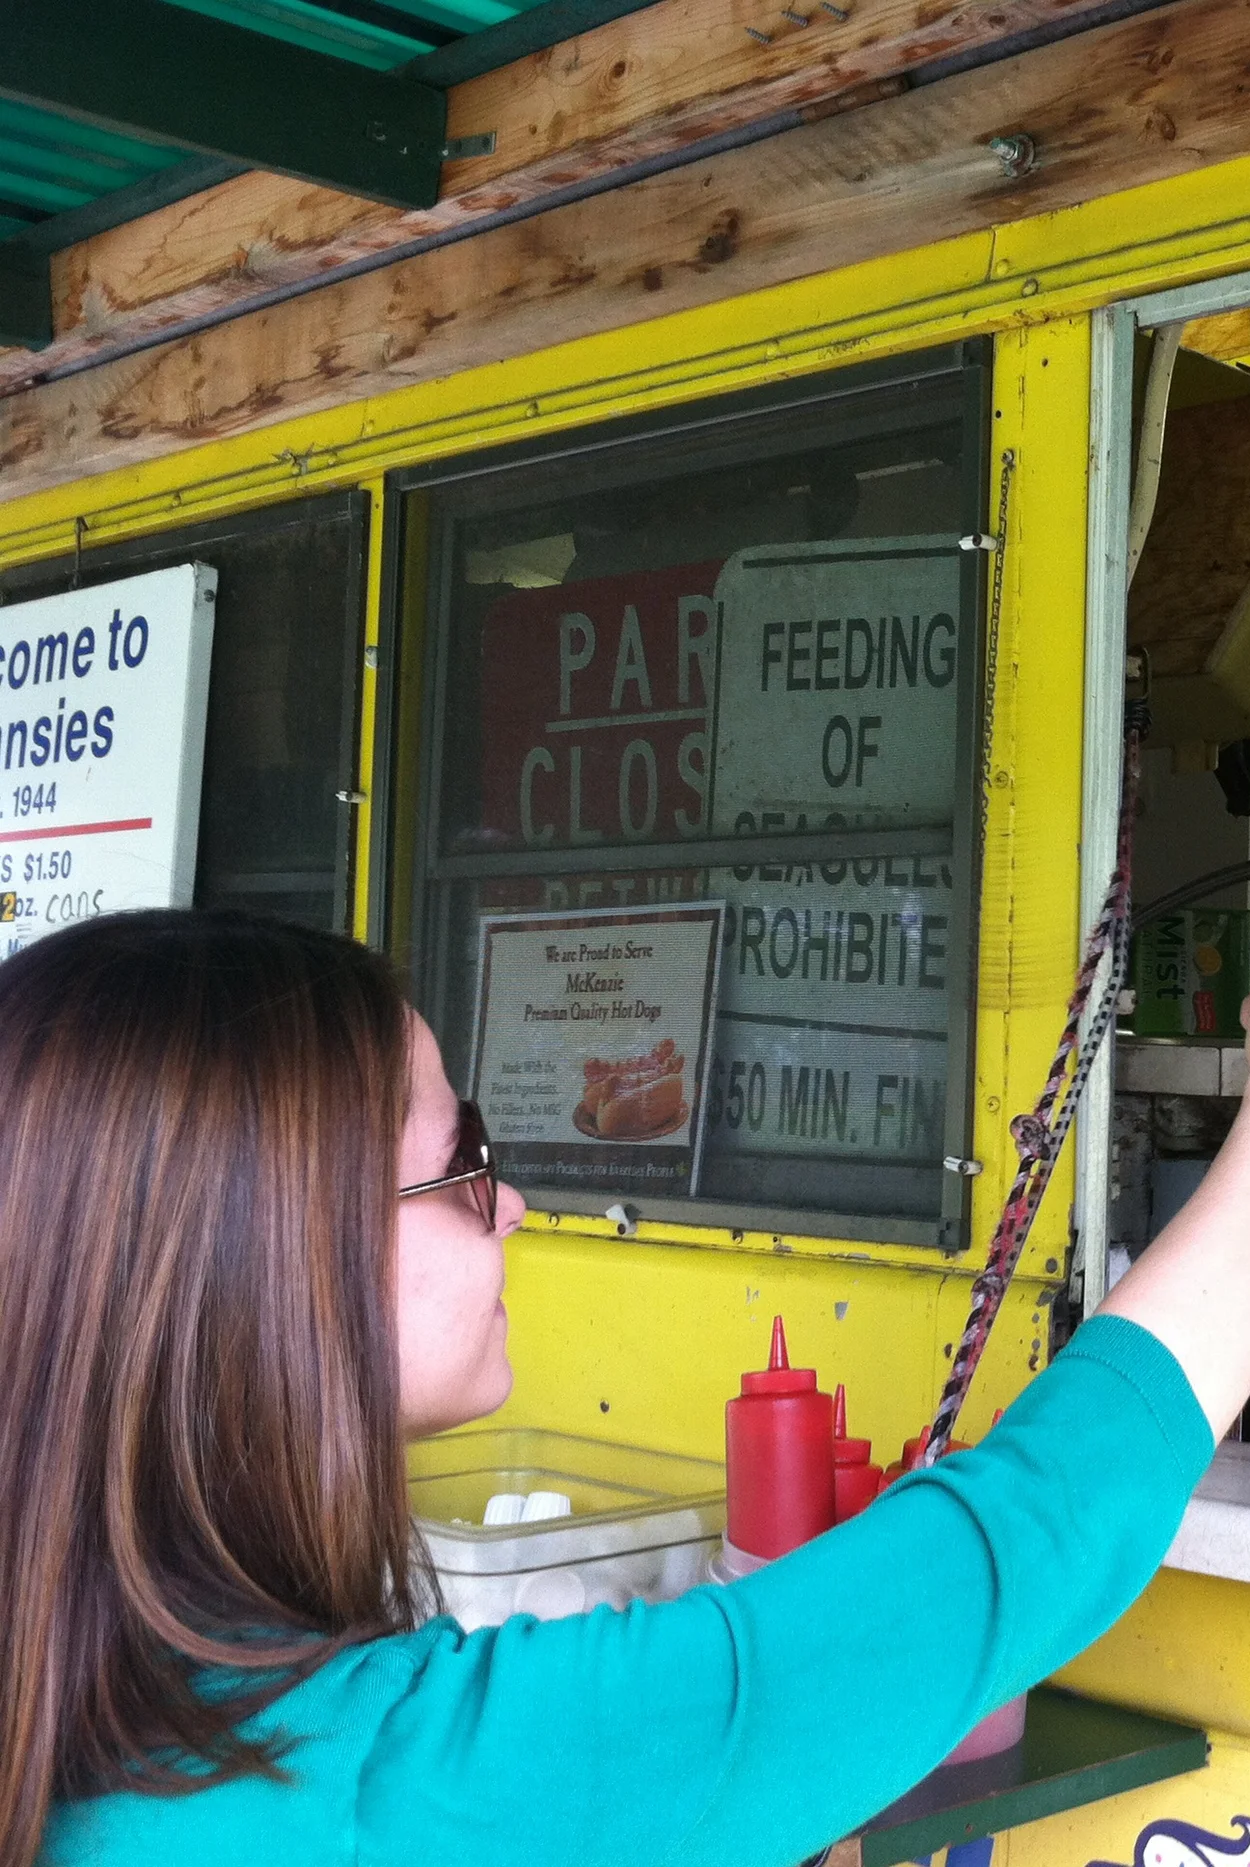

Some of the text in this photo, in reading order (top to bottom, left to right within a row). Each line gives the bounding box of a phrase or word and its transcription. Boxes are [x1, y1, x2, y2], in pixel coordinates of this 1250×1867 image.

[0, 609, 149, 690] ome to
[559, 594, 715, 715] PAR
[761, 612, 956, 692] FEEDING
[0, 697, 114, 770] nsies
[822, 714, 883, 788] OF
[13, 782, 56, 817] 1944
[520, 732, 707, 846] CLOS
[0, 850, 72, 884] S $1.50
[733, 811, 953, 889] SEAGULL
[546, 940, 653, 963] We are Proud to Serve
[565, 971, 624, 993] McKenzie
[523, 999, 662, 1025] Premium Quality Hot Dogs
[777, 1065, 857, 1144] MIN.
